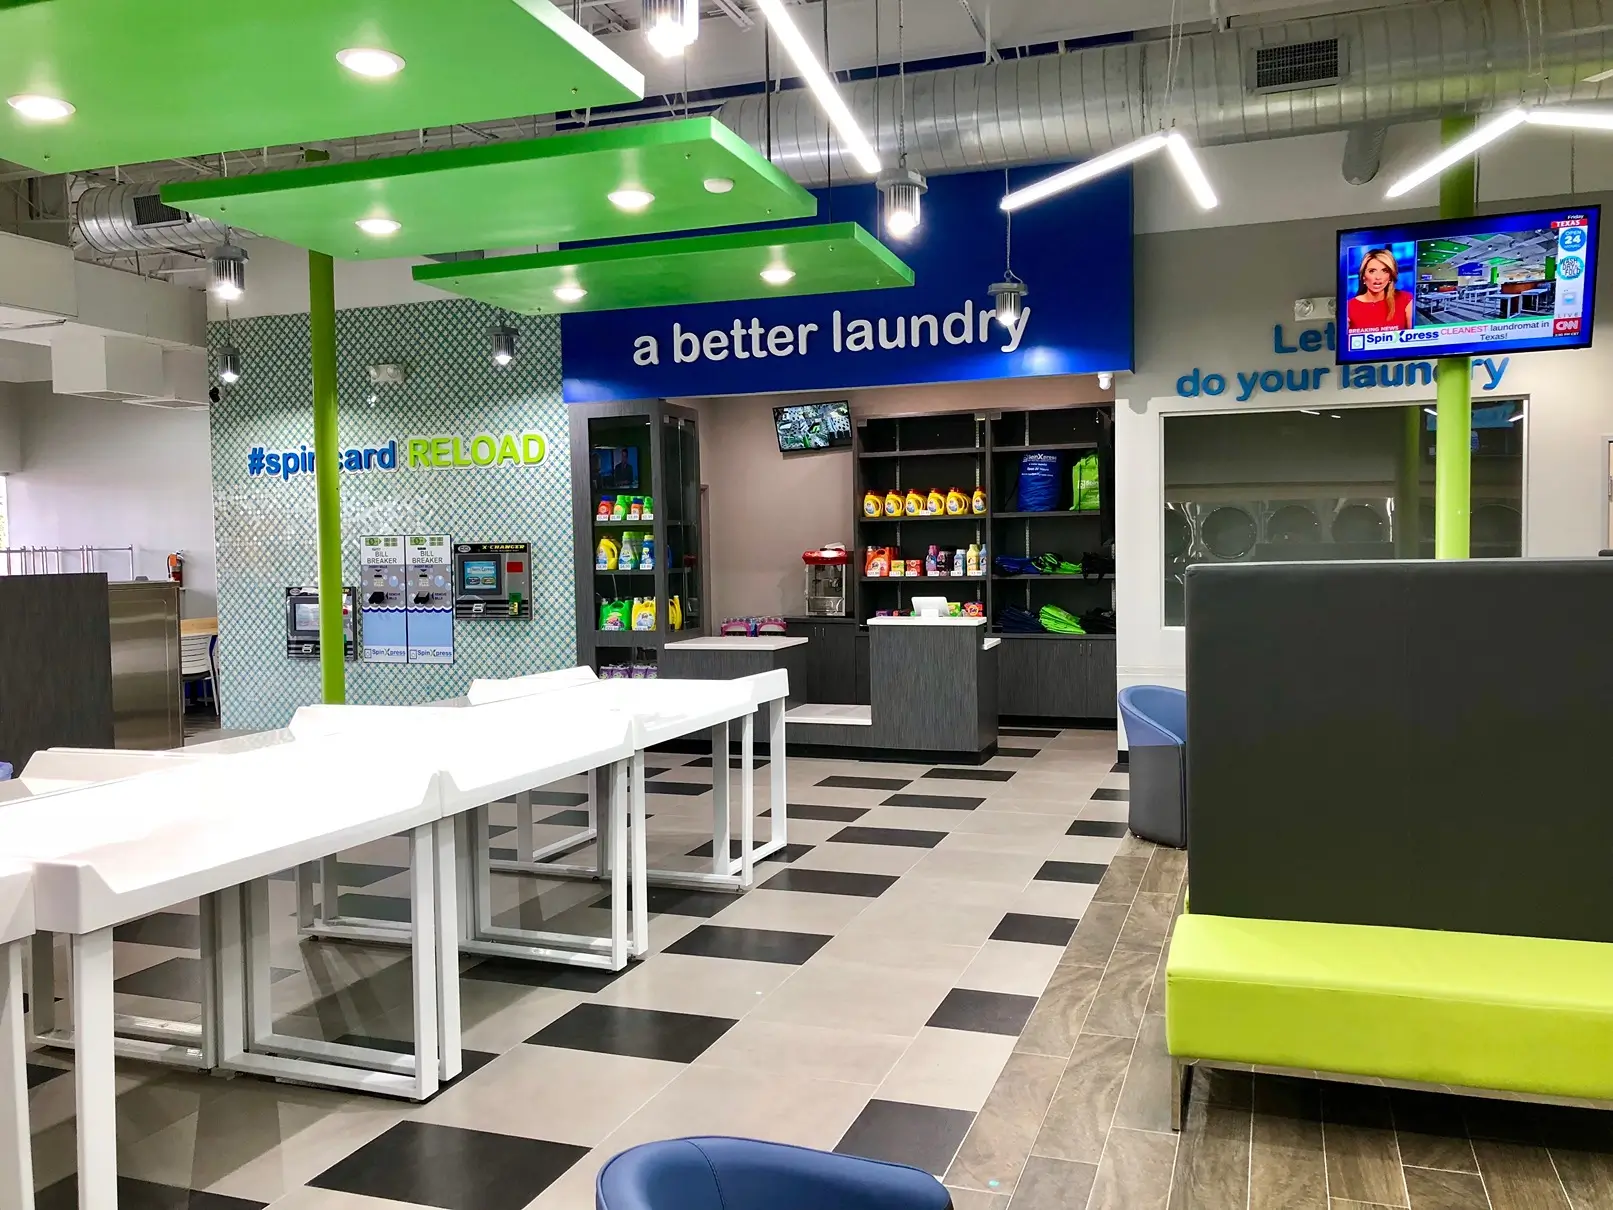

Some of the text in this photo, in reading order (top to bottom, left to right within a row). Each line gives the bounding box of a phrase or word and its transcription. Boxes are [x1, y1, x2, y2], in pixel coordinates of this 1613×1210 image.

[1556, 219, 1580, 228] TEXAS
[1564, 235, 1581, 245] 24
[1564, 267, 1581, 275] FOLD
[1348, 326, 1379, 334] BREAKING
[1440, 325, 1489, 336] CLEANEST
[1490, 321, 1539, 332] laundromat
[1556, 320, 1578, 331] CNN
[632, 299, 1031, 367] a better laundry
[1480, 332, 1508, 341] Texas!
[1176, 356, 1510, 401] do your launry
[247, 434, 546, 482] #spiard RELOAD
[372, 648, 406, 657] SpinXpress
[418, 648, 452, 658] SpinXpress
